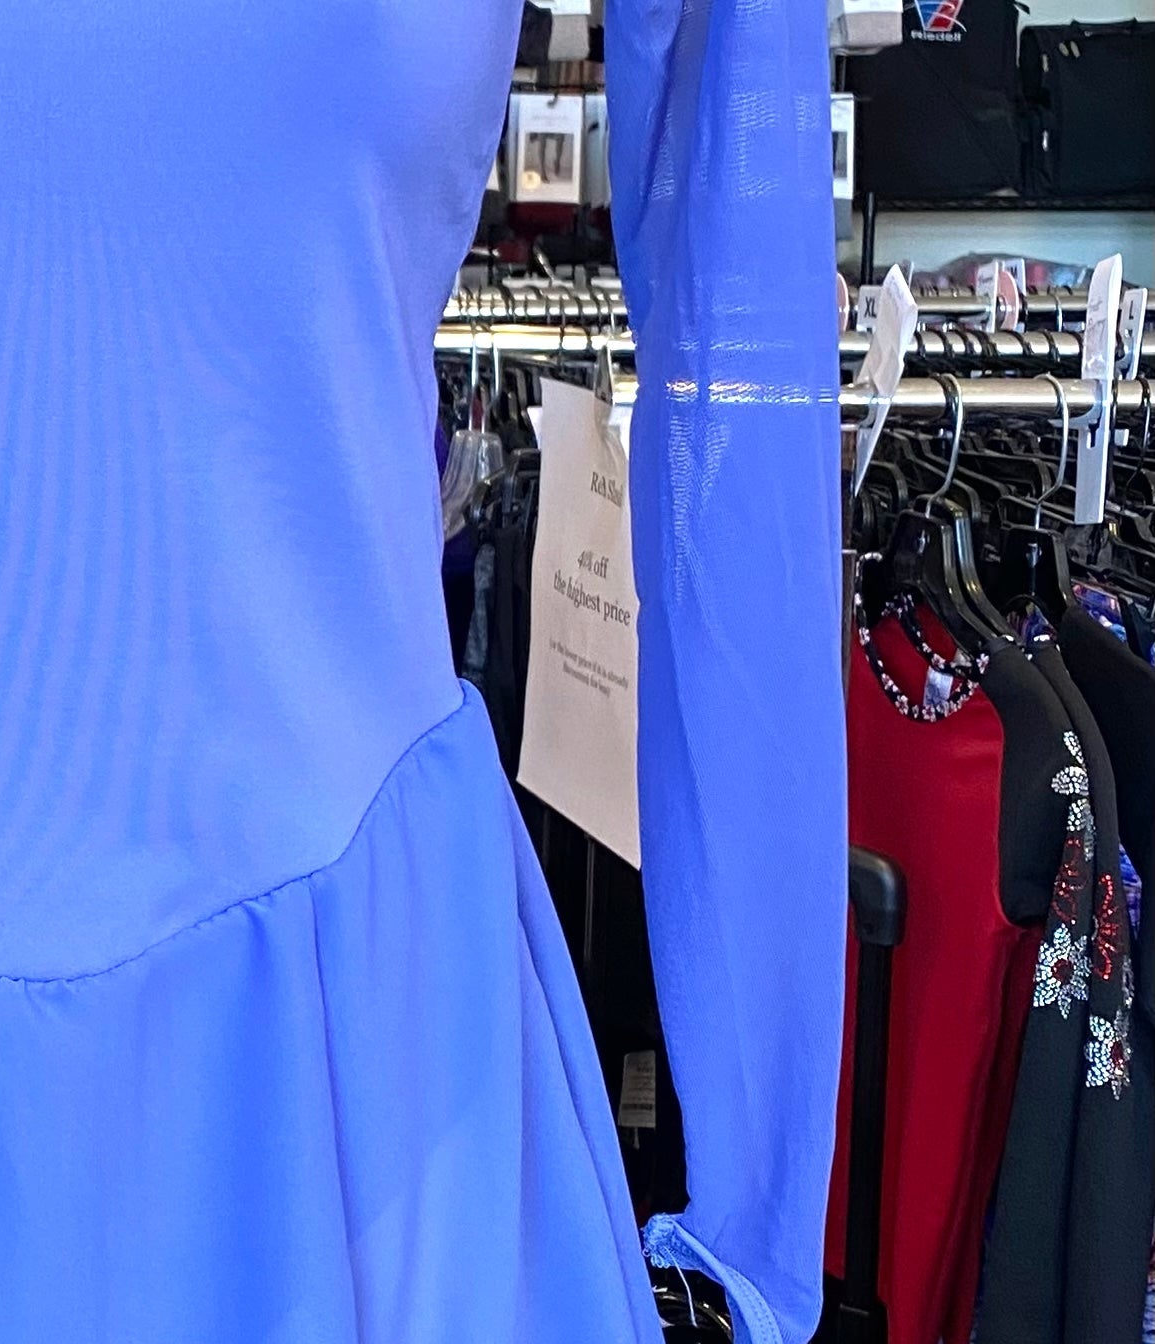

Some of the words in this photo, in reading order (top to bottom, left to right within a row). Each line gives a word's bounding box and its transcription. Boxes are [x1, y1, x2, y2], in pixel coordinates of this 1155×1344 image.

[864, 296, 877, 318] XL
[593, 556, 609, 578] off
[566, 576, 600, 613] highest
[603, 599, 631, 626] price
